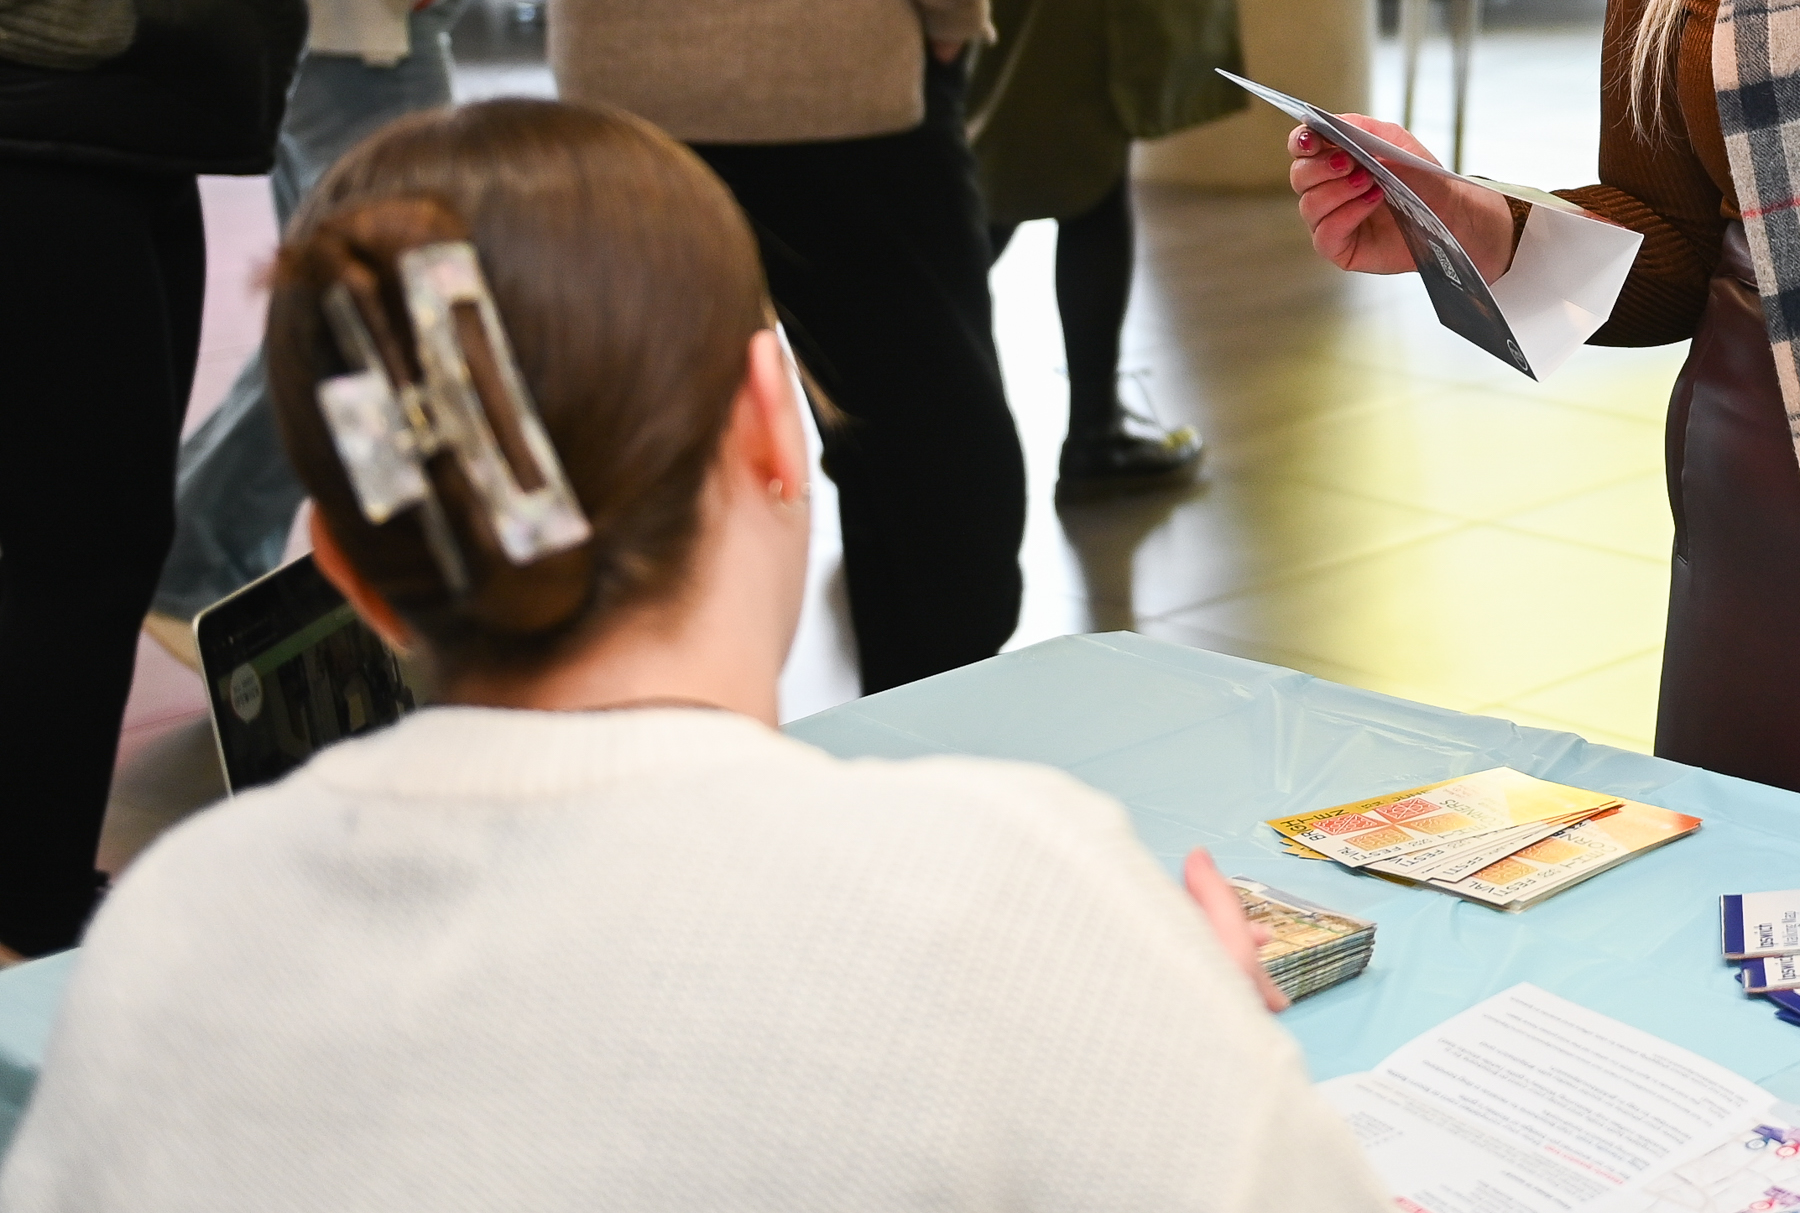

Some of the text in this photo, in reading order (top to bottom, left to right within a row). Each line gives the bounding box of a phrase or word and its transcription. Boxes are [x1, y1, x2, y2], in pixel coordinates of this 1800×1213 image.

[1469, 876, 1536, 897] FESTIVAL
[1755, 922, 1780, 949] Ipswich
[1781, 910, 1800, 946] Walking Map
[1776, 954, 1800, 980] Ipswic
